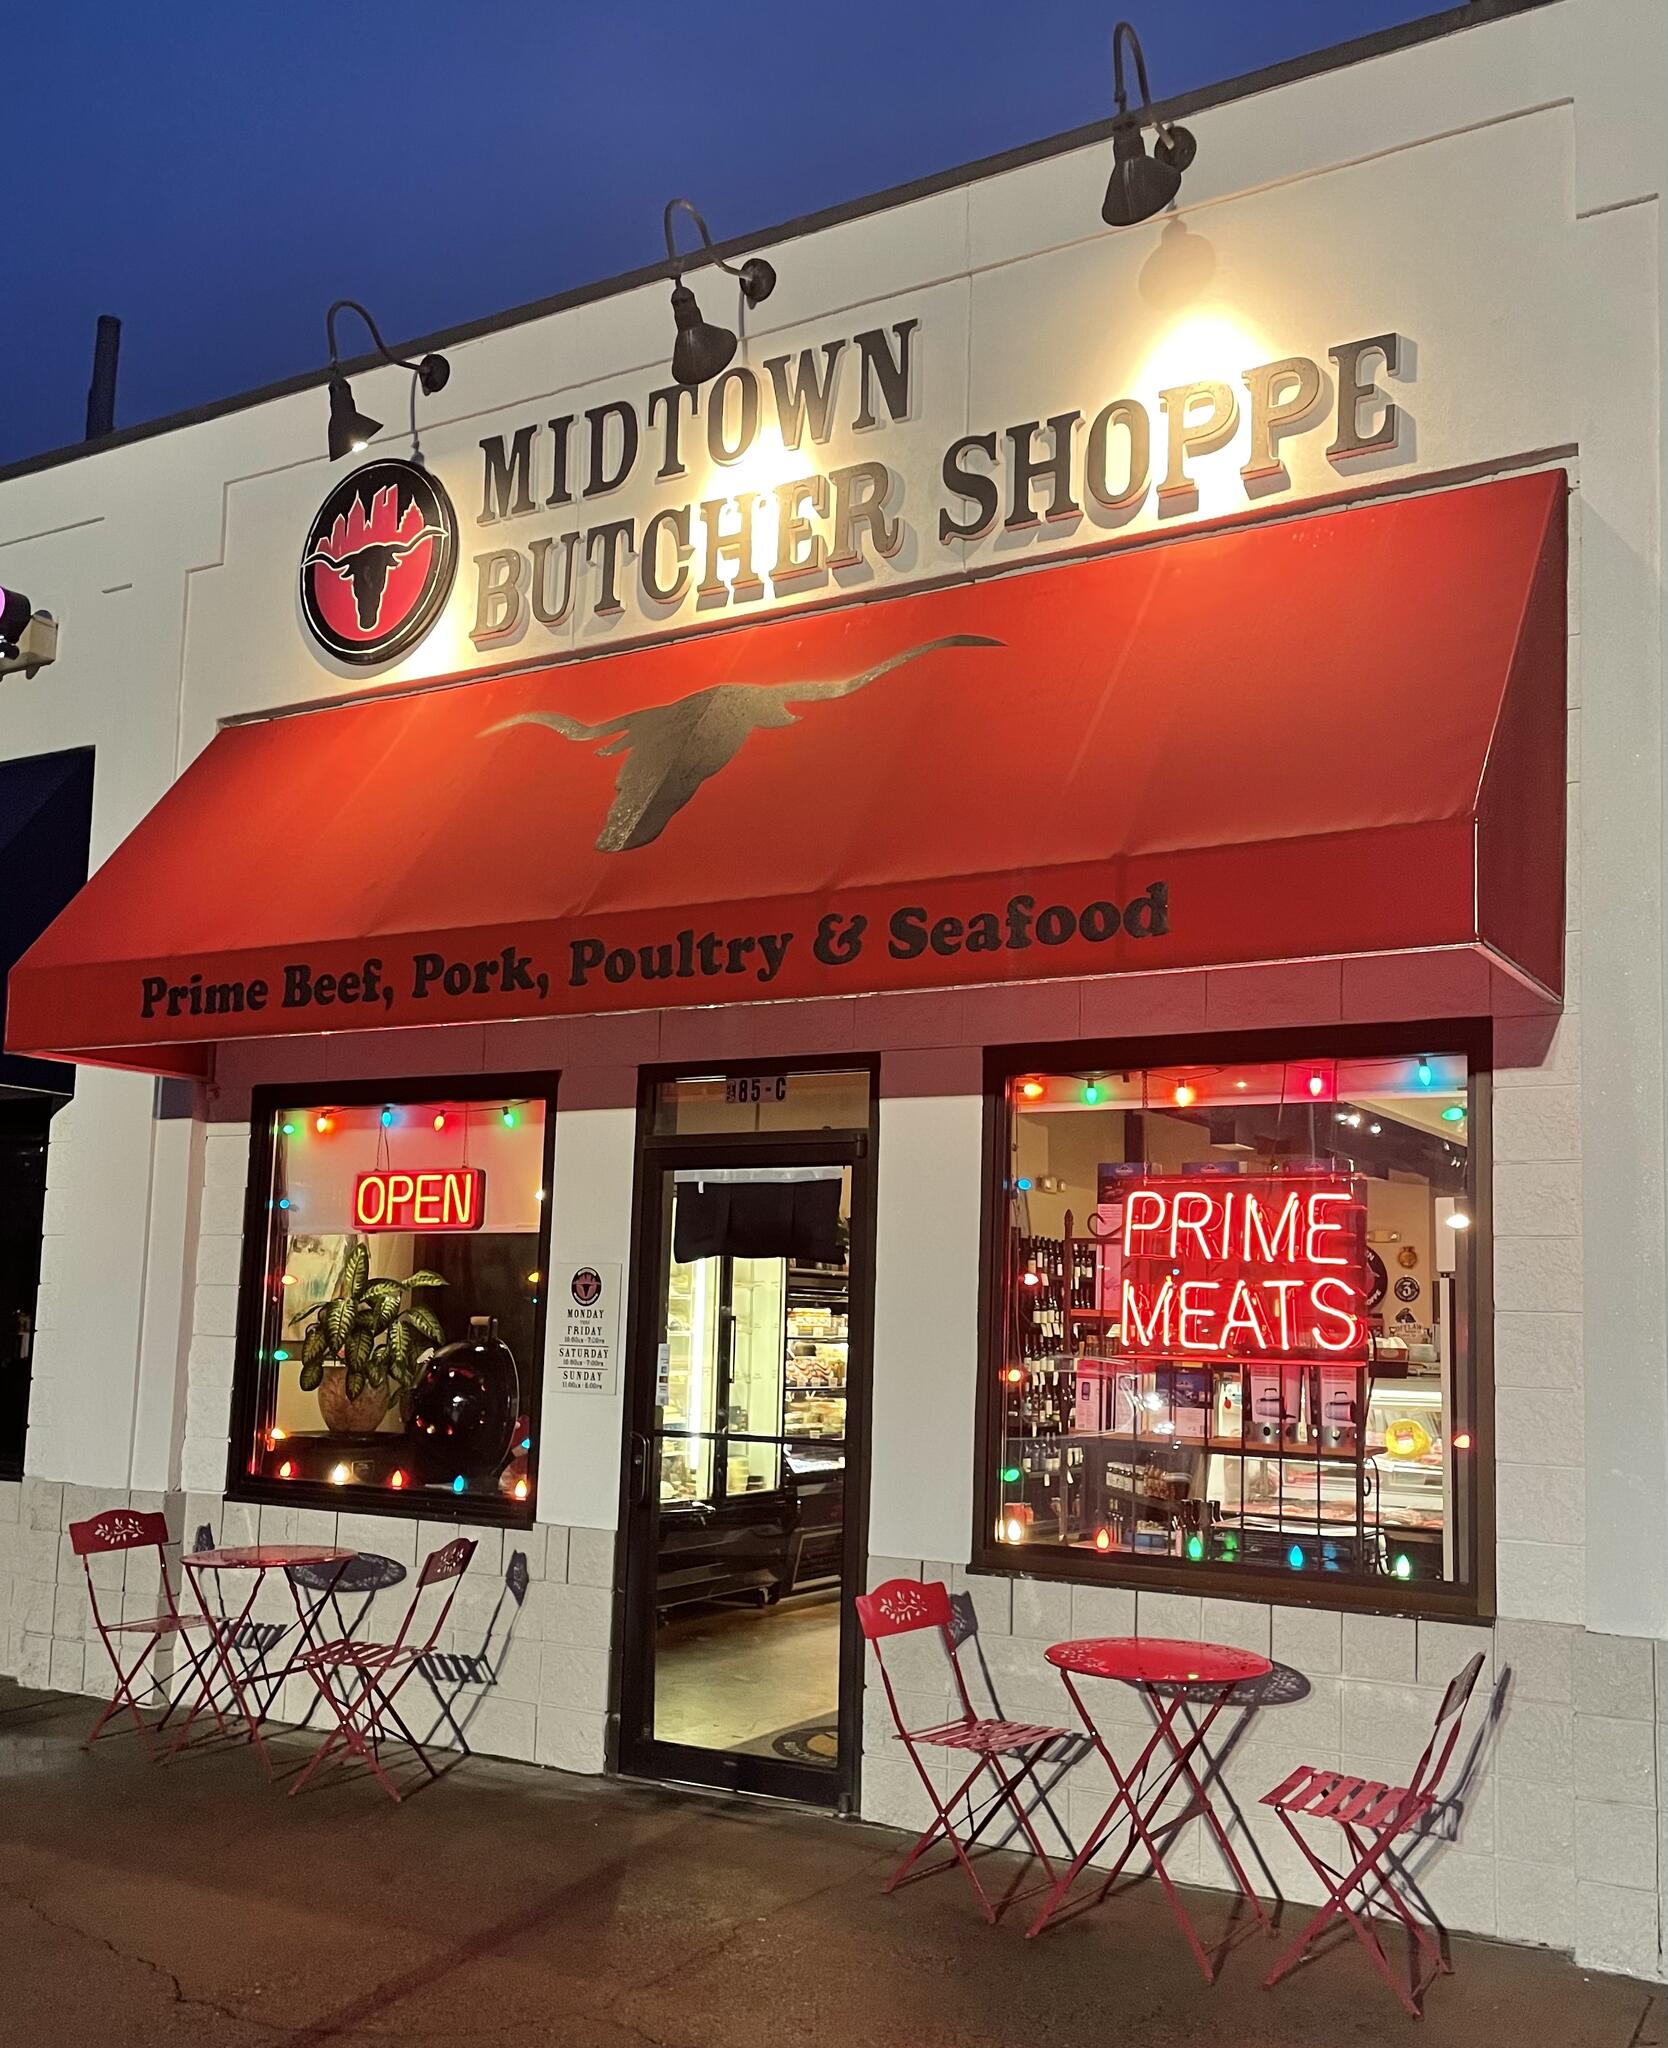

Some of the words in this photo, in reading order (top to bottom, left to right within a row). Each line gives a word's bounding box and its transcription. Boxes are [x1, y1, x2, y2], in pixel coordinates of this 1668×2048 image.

[476, 318, 920, 526] MIDTOWN
[469, 461, 904, 642] BUTCHER
[939, 332, 1400, 546] SHOPPE
[140, 974, 268, 1018] Prime
[282, 958, 394, 1011] Beef,
[411, 946, 549, 999] Pork,
[568, 929, 794, 986] Poultry
[812, 912, 868, 966] &
[887, 881, 1170, 961] Seafood
[357, 1173, 472, 1225] OPEN
[1124, 1191, 1353, 1265] PRIME
[567, 1308, 604, 1319] MONDAY
[567, 1325, 603, 1336] FRIDAY
[1121, 1277, 1357, 1351] MEATS
[559, 1347, 609, 1359] SATURDAY
[562, 1370, 603, 1381] SUNDAY
